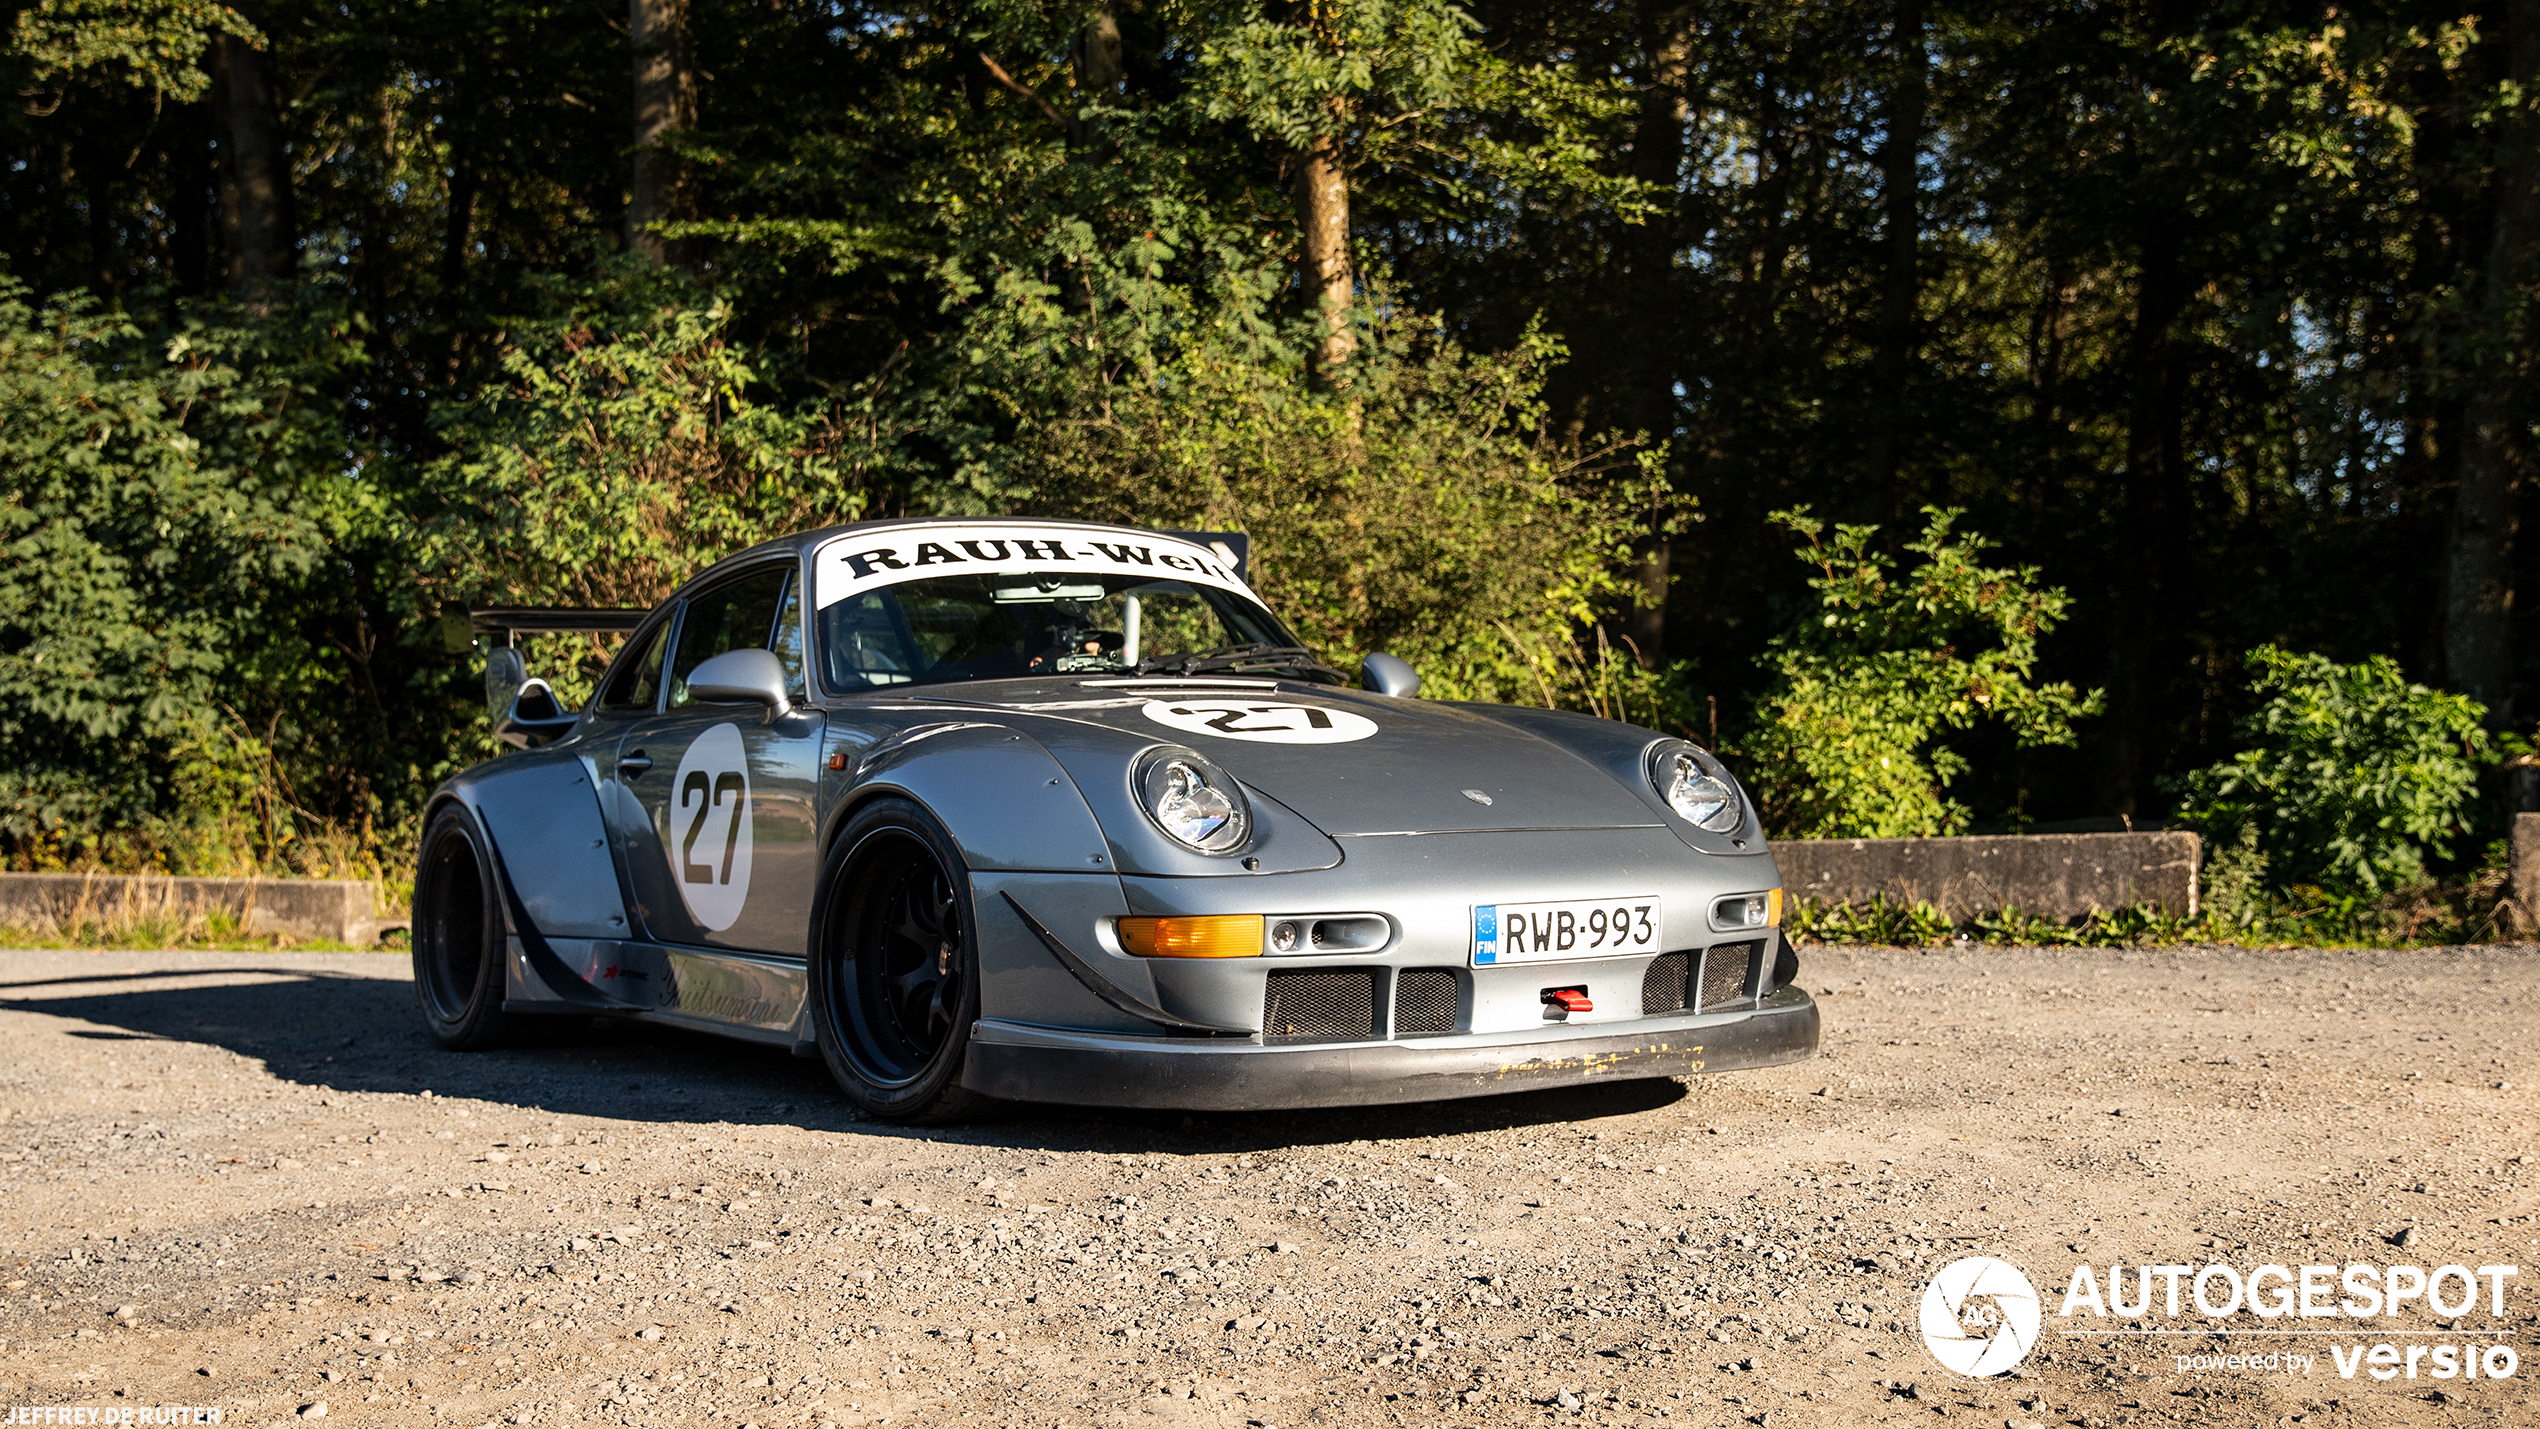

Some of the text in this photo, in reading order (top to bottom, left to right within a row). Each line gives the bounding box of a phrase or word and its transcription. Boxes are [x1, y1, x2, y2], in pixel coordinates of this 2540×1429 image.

[841, 539, 1235, 585] RAUH-Welt
[1169, 707, 1333, 733] 27
[682, 770, 745, 885] 27
[1477, 941, 1496, 954] FIN
